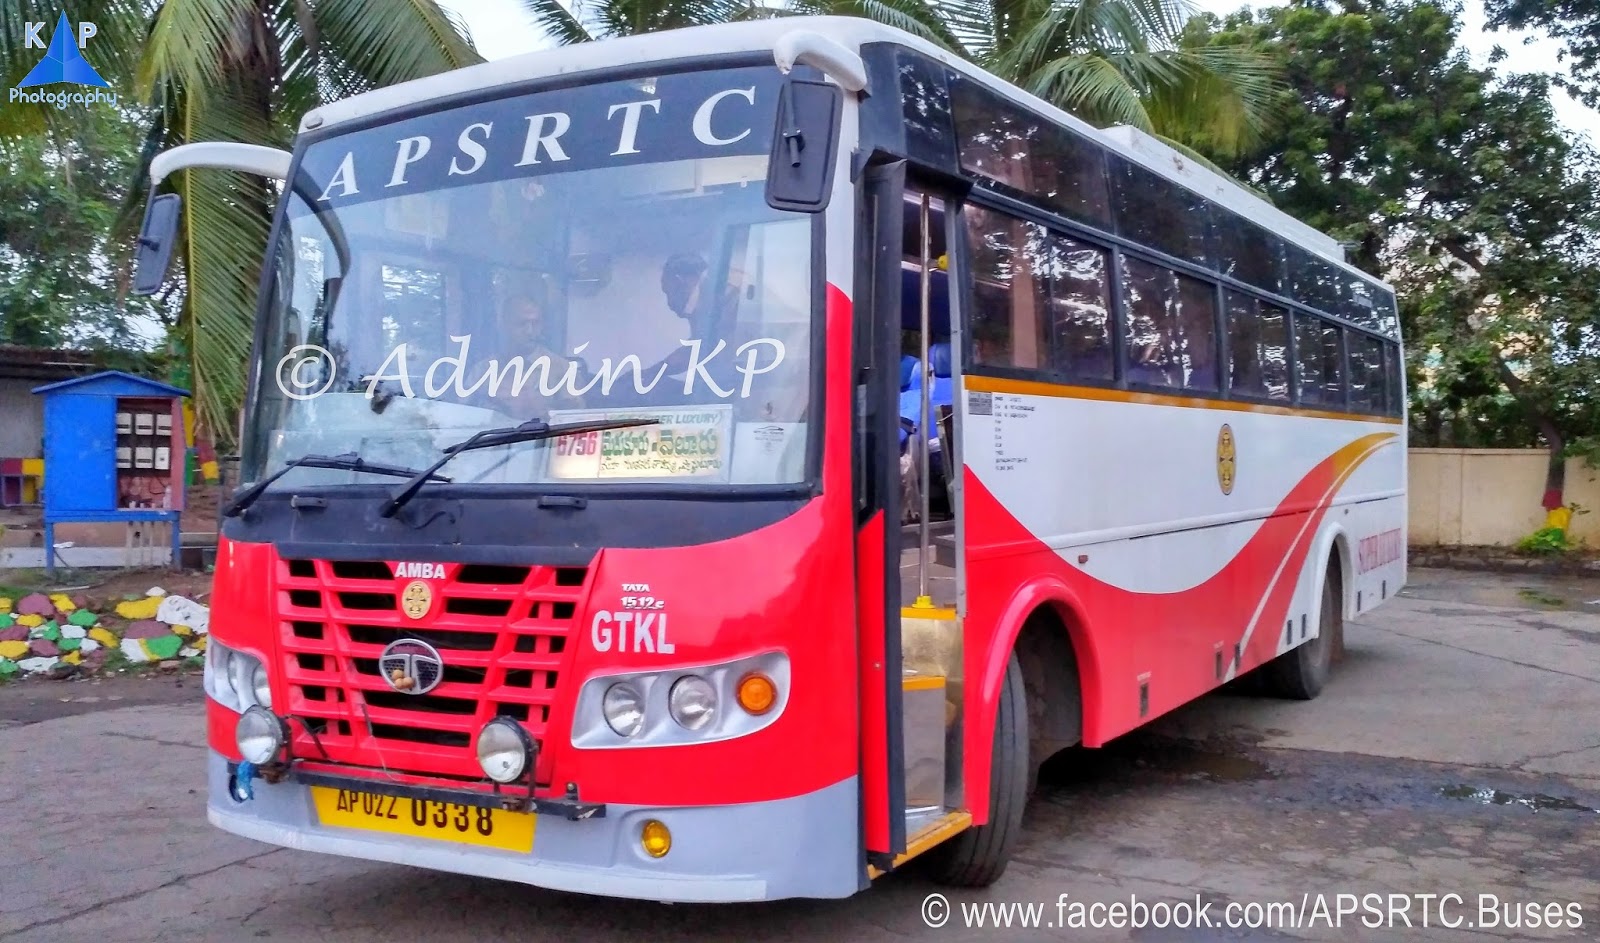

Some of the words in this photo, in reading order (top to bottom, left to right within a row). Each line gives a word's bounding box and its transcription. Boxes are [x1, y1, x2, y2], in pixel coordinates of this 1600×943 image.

[317, 85, 757, 202] APSRTC
[394, 562, 446, 580] AMBA
[621, 583, 650, 593] TATA
[591, 609, 675, 655] GTKL
[411, 798, 494, 837] 0338
